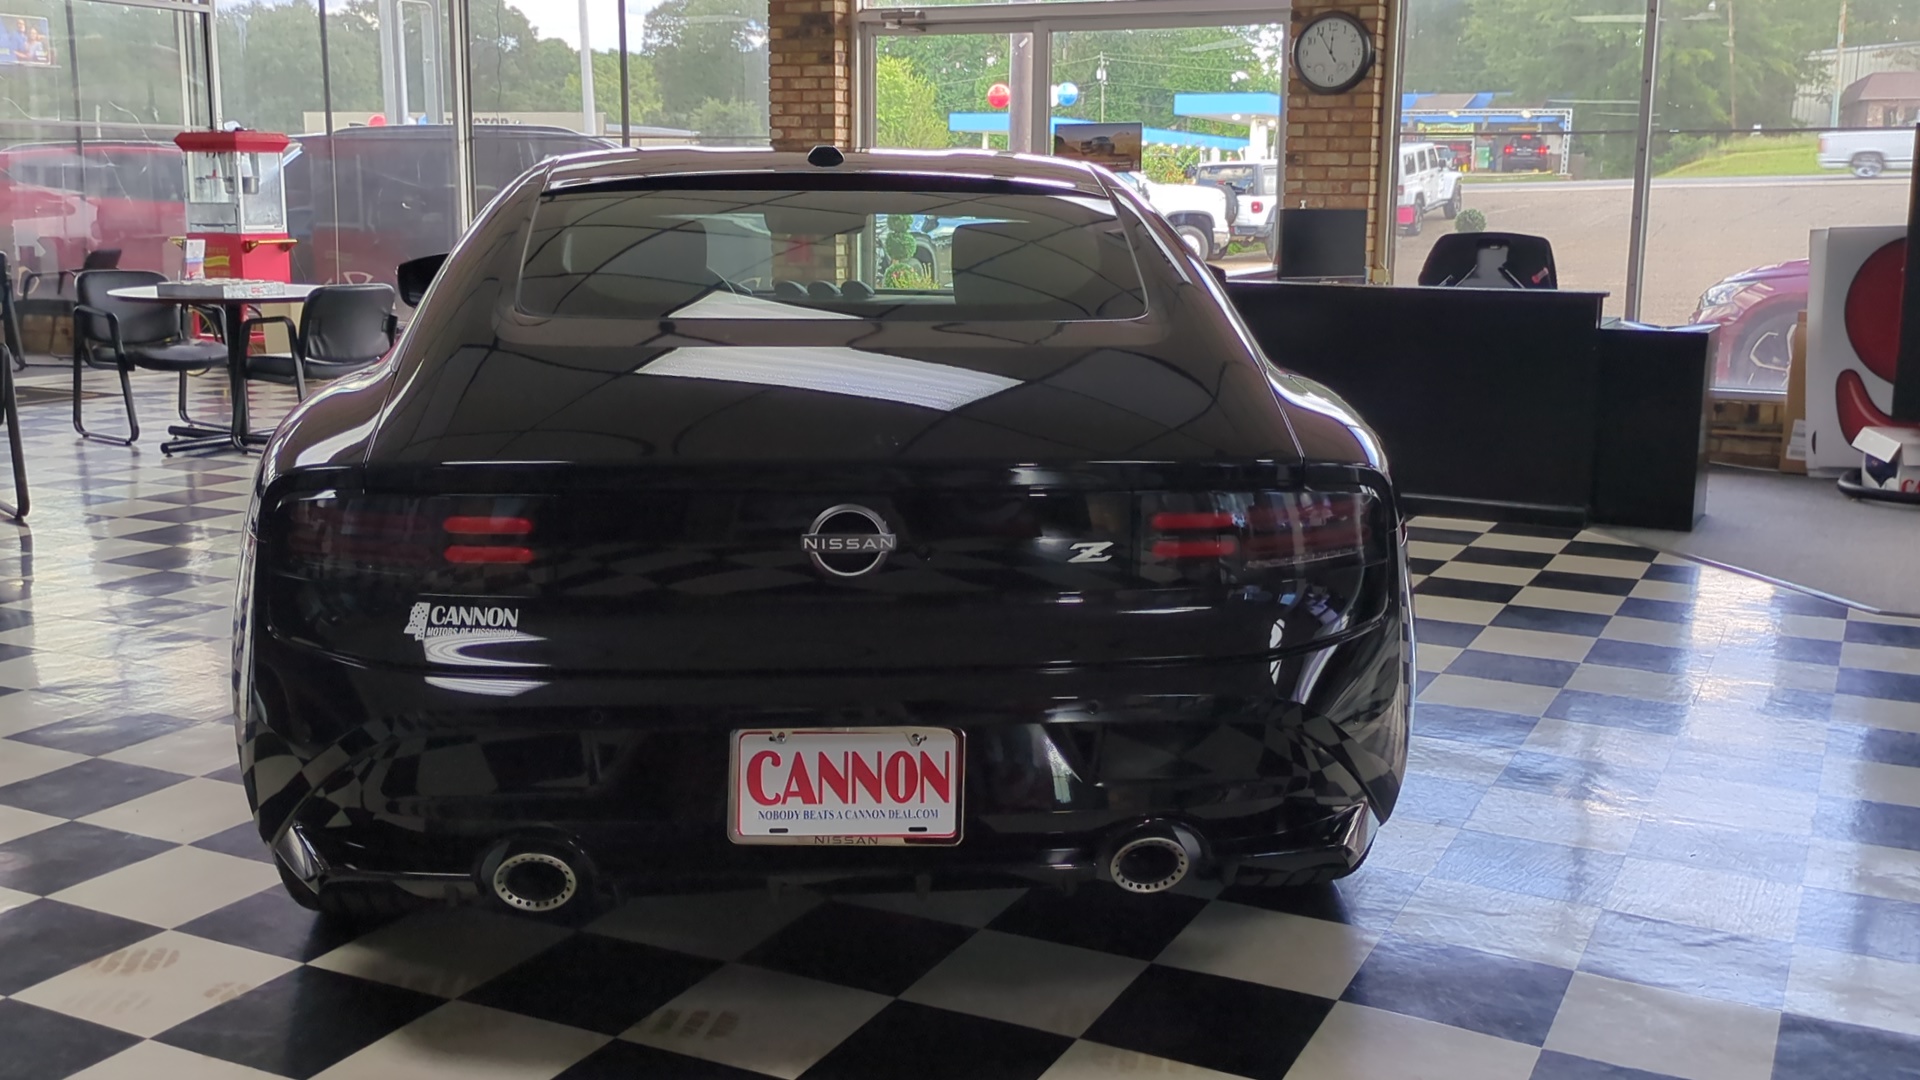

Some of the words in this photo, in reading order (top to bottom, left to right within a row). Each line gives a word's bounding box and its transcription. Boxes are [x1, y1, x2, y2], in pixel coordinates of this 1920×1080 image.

[1328, 22, 1338, 32] 12
[803, 537, 895, 550] NISSAN
[1067, 541, 1114, 563] Z
[430, 605, 519, 628] CANNON
[426, 626, 459, 637] MOTORS
[460, 627, 471, 637] OF
[746, 750, 950, 806] CANNON
[757, 810, 800, 820] NOBODY
[803, 810, 835, 820] BEATS
[837, 811, 844, 820] A
[845, 809, 886, 820] CANNON
[888, 809, 939, 819] DEAL.COM
[814, 836, 879, 845] NISSAN
